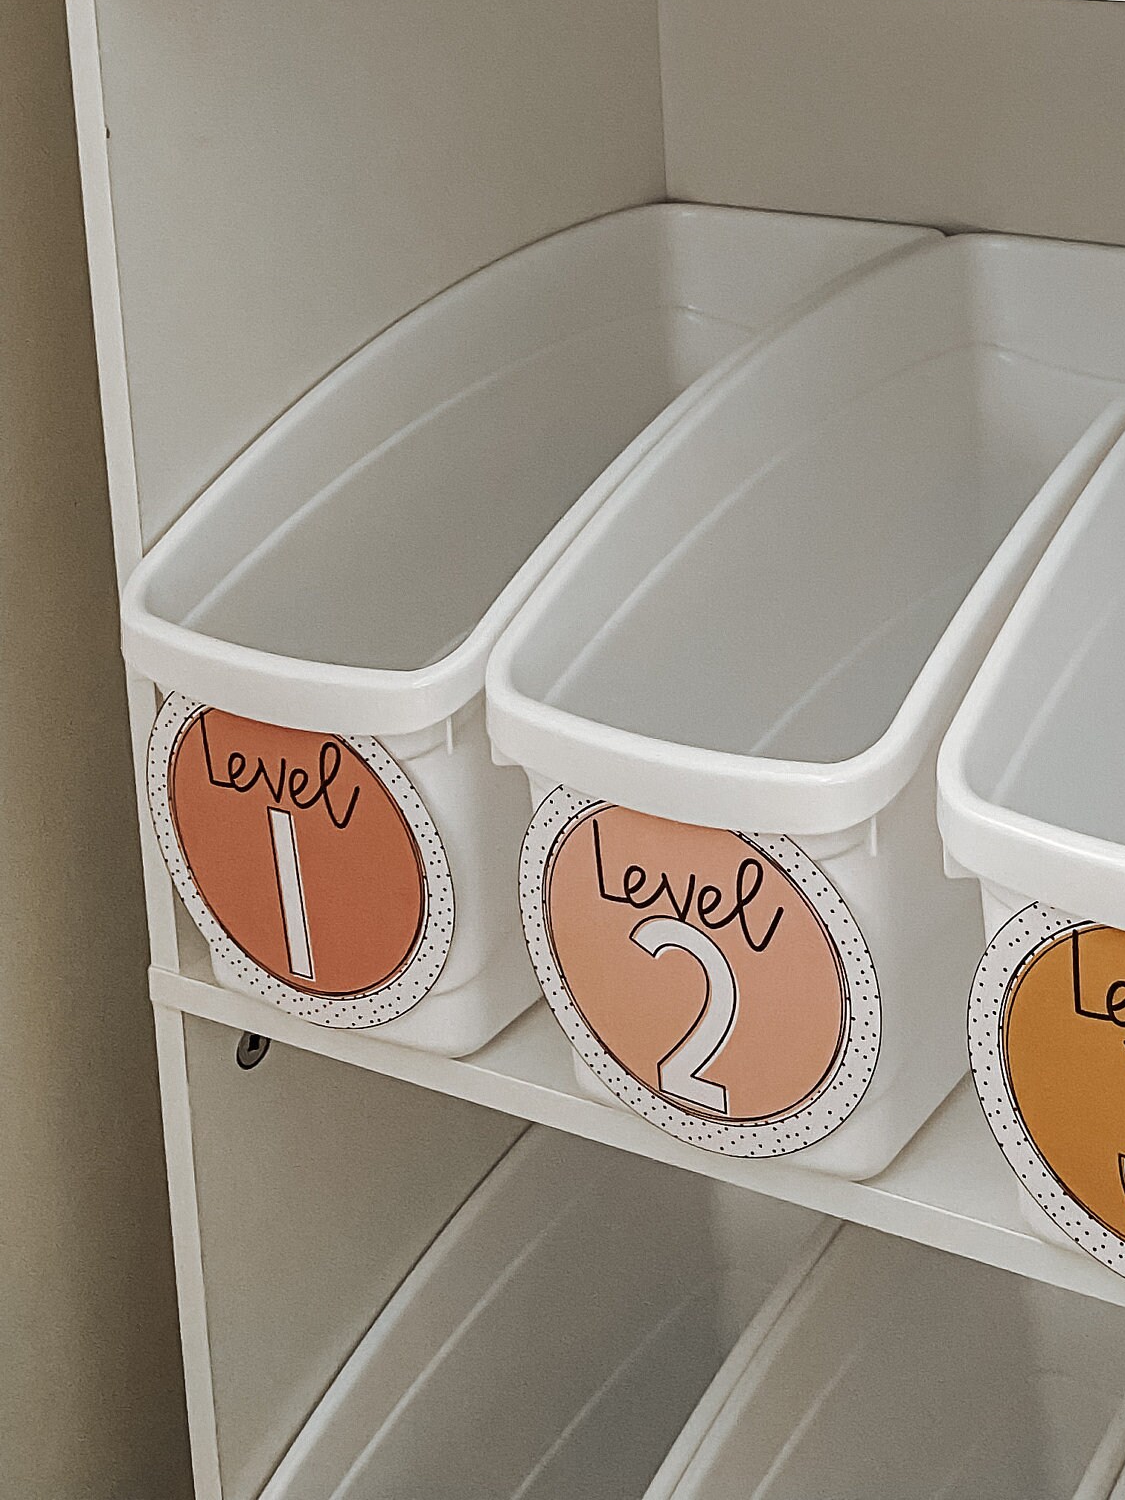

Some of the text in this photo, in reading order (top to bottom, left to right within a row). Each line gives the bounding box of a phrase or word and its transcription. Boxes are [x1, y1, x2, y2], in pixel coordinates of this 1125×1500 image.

[199, 711, 361, 829] Level
[266, 805, 317, 982] 1
[592, 818, 785, 953] Level
[629, 914, 738, 1116] 2
